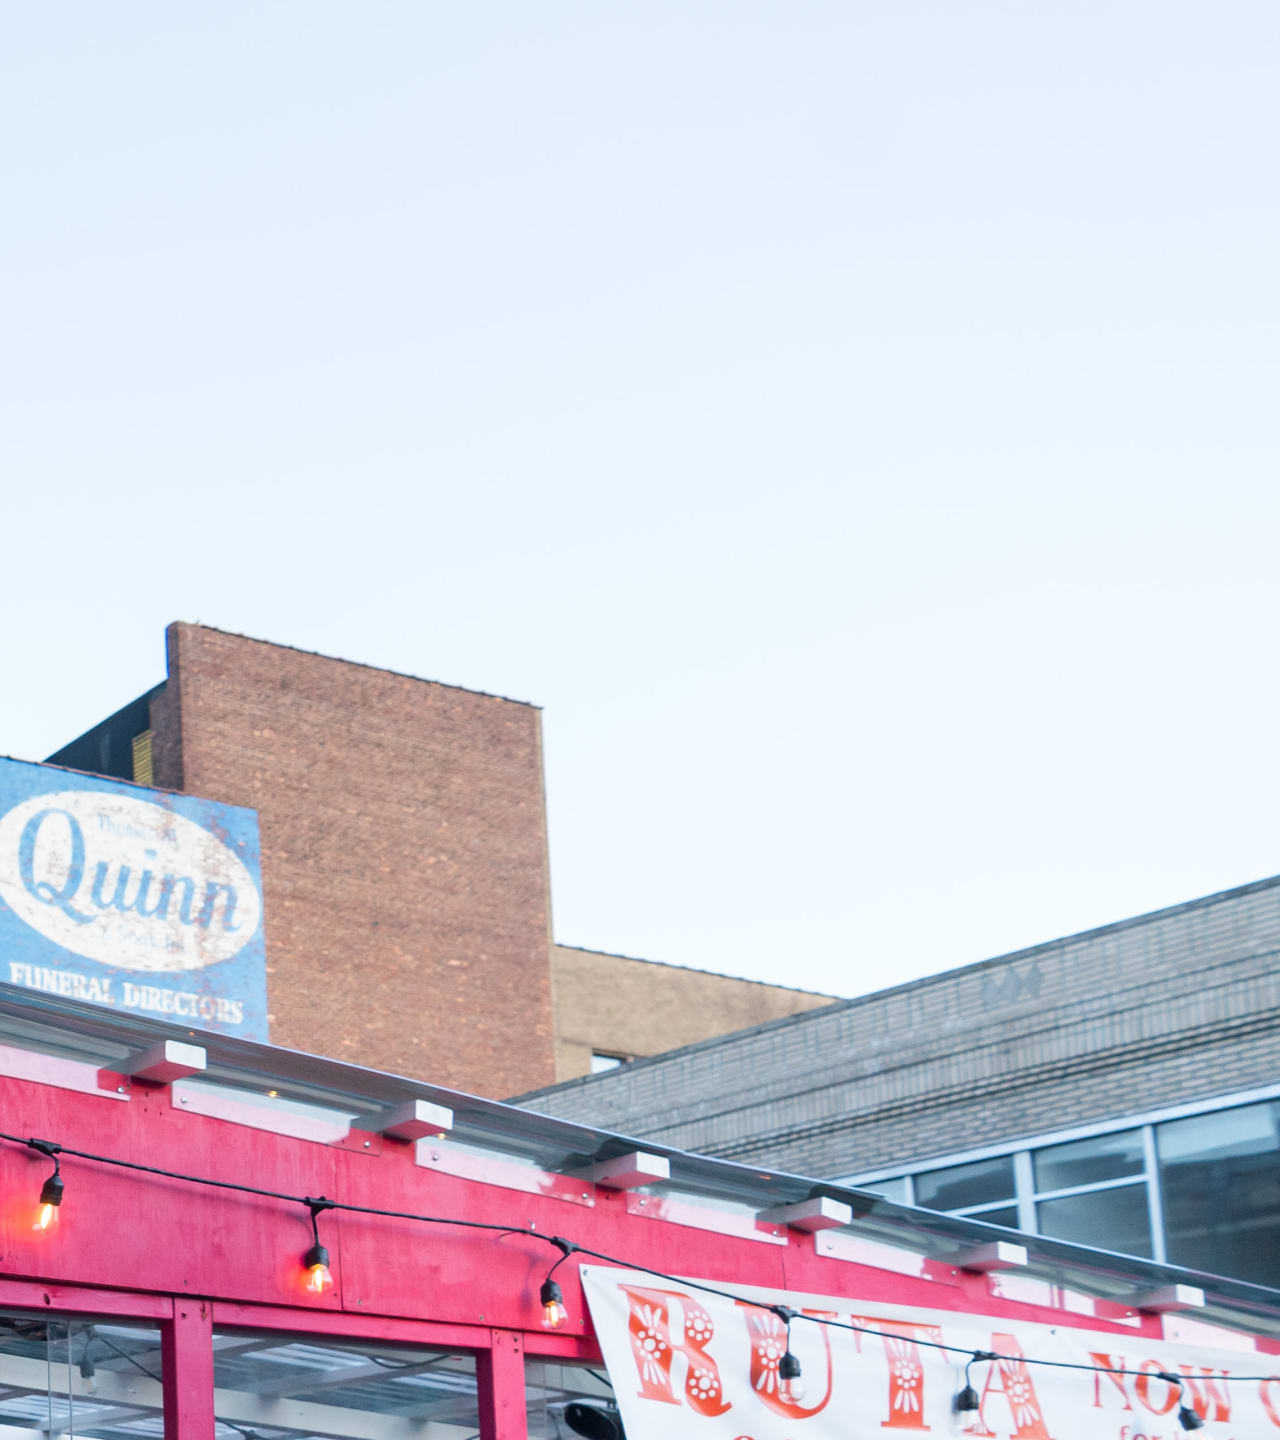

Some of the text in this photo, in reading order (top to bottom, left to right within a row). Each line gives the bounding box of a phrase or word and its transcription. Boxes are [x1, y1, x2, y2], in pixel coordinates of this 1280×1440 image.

[17, 808, 244, 932] Quinn
[9, 962, 244, 1025] FUNERAL DIRECTORS
[1088, 1352, 1231, 1423] NOW
